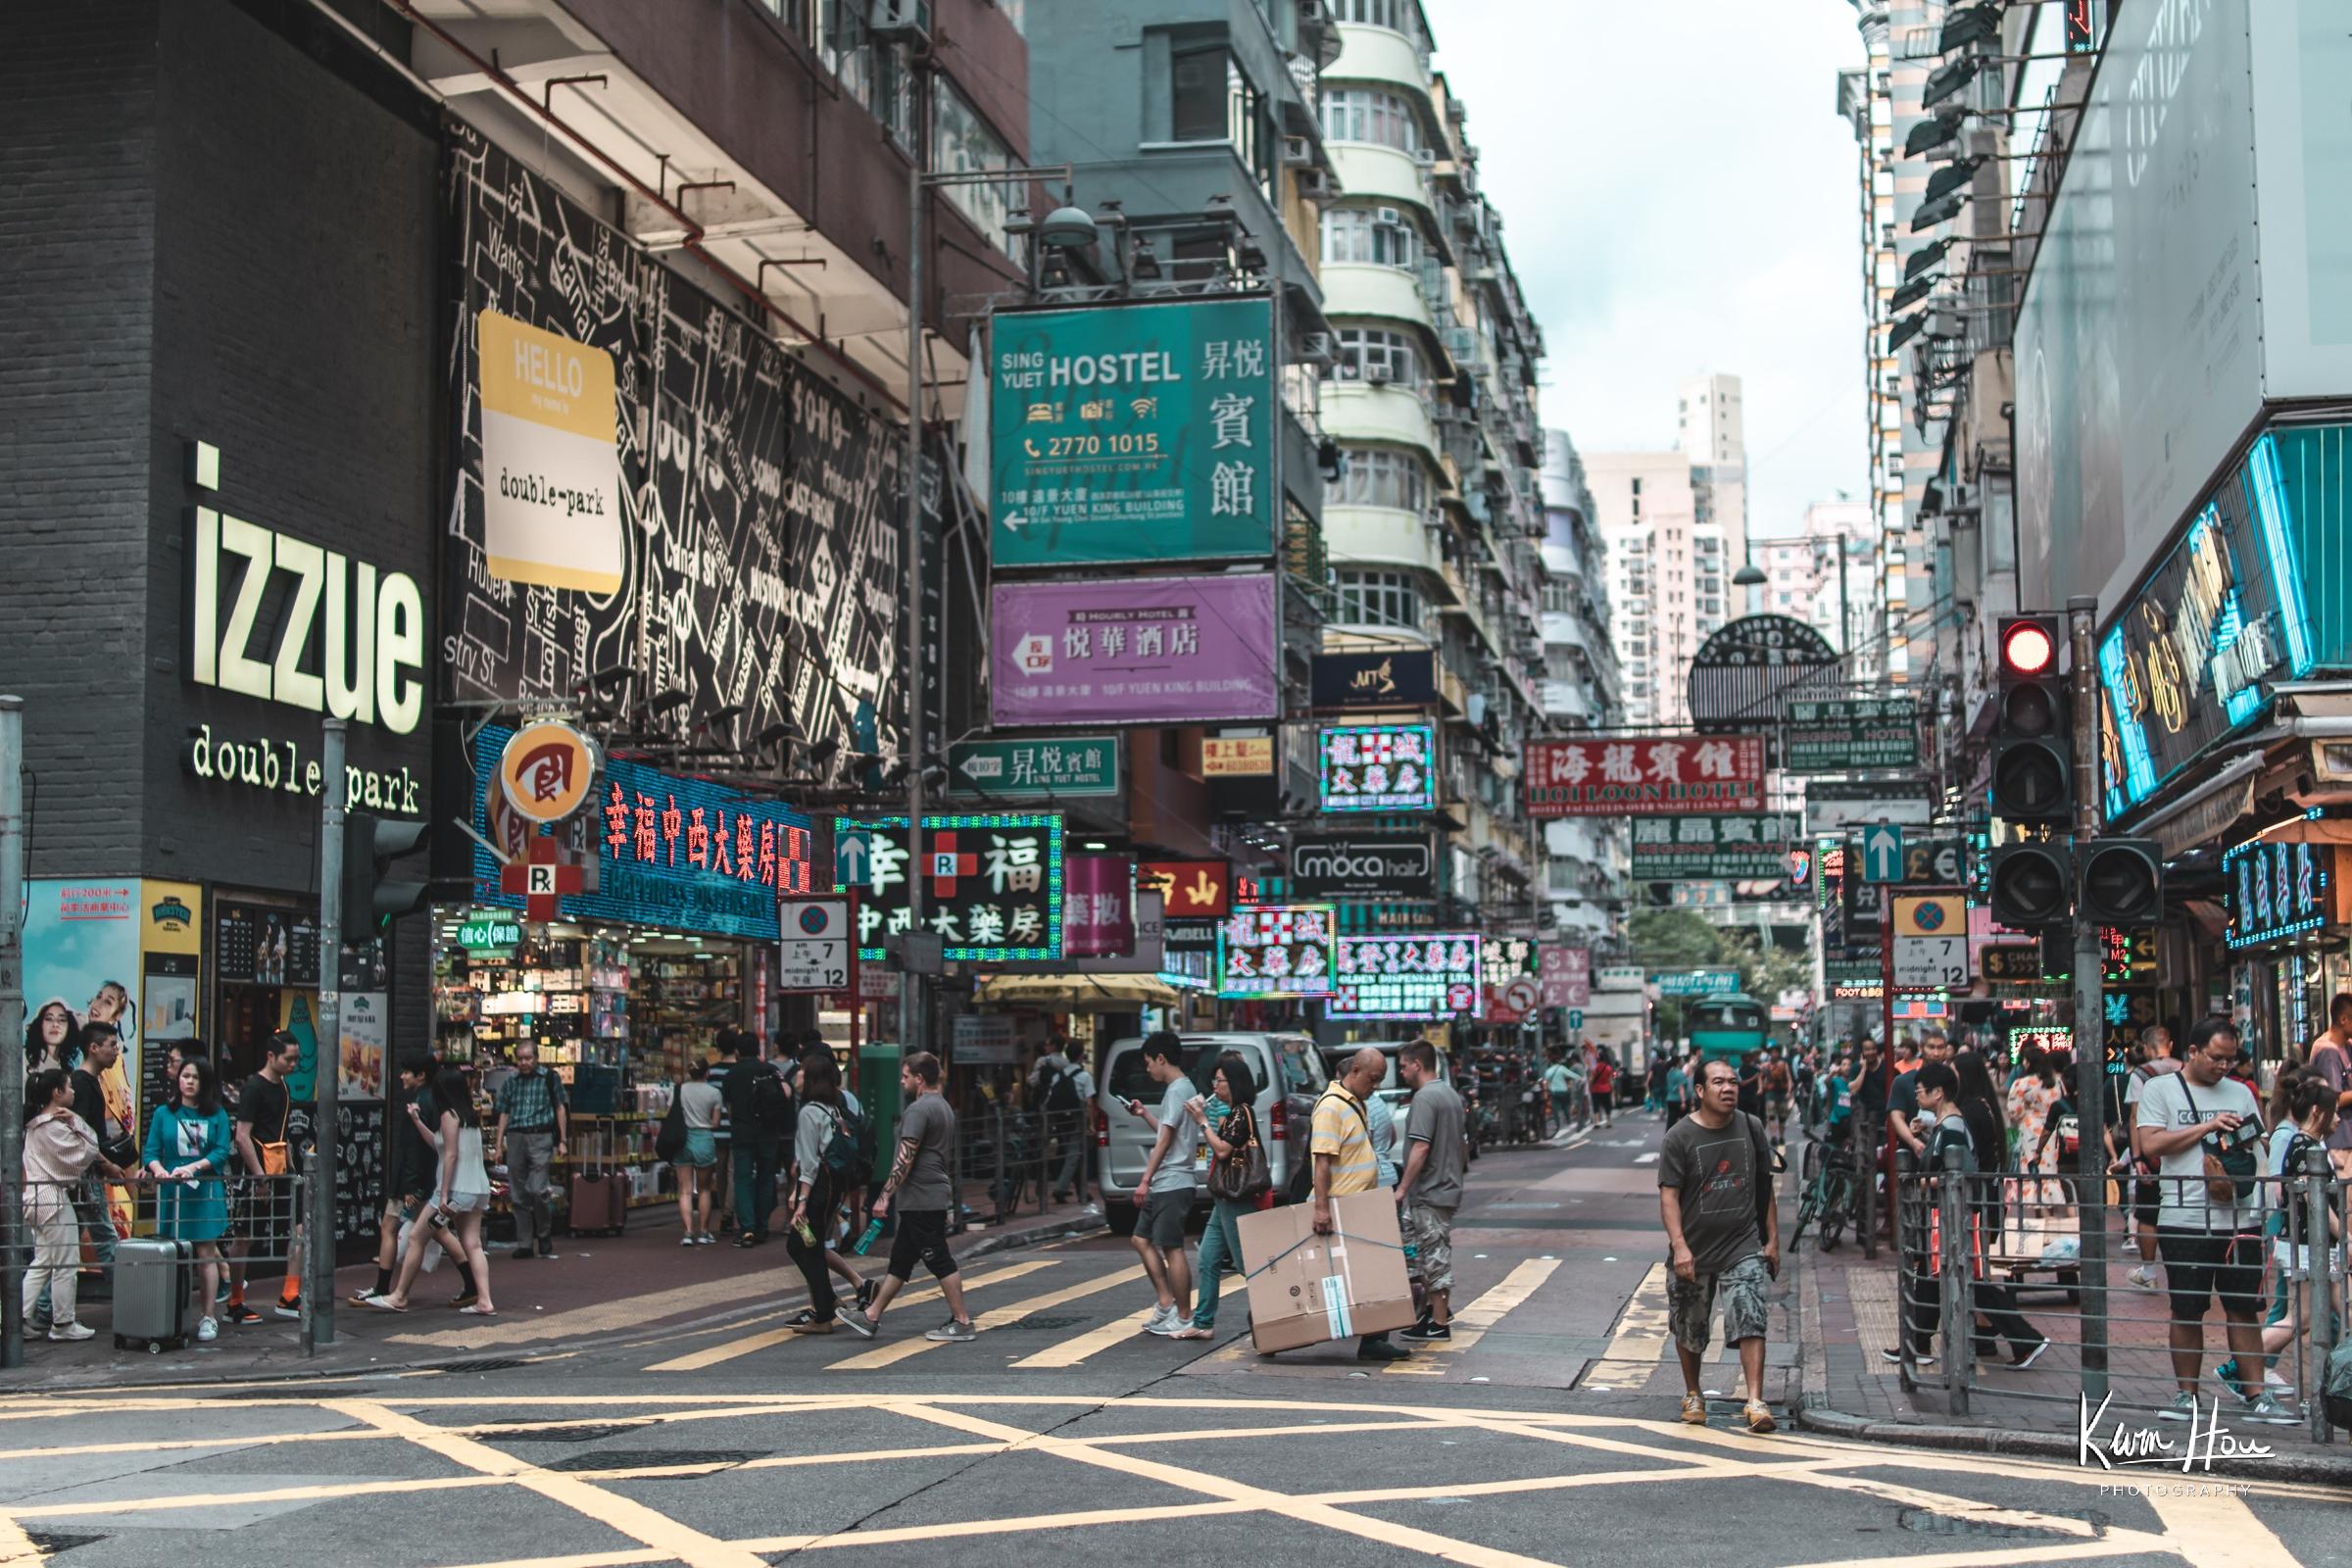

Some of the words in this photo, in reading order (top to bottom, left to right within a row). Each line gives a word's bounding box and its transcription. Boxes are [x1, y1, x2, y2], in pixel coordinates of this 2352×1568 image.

[489, 219, 524, 286] Watts
[514, 338, 583, 398] HELLO
[1002, 352, 1045, 369] SING
[1050, 352, 1181, 386] HOSTEL
[1002, 371, 1045, 389] YUET
[1049, 436, 1100, 456] 2770
[1108, 433, 1158, 454] 1015
[499, 467, 606, 519] double-park
[1023, 506, 1048, 517] 10/F
[1054, 504, 1088, 515] YUEN
[1092, 502, 1120, 514] KING
[1125, 499, 1185, 513] BUILDING
[664, 532, 700, 581] Canal
[702, 549, 716, 588] St
[707, 516, 735, 587] Grand
[815, 554, 833, 590] 22
[194, 440, 423, 735] izzue
[751, 565, 800, 617] HISTORIC
[525, 583, 542, 630] St.
[1089, 610, 1135, 620] HOURLY
[1138, 609, 1174, 619] HOTEL
[710, 602, 732, 663] West
[760, 632, 784, 712] Greene
[1128, 681, 1160, 695] YUEN
[1163, 680, 1193, 694] KING
[1196, 678, 1253, 694] BUILDING
[1864, 728, 1914, 741] HOTEL
[193, 725, 321, 796] double
[345, 764, 419, 813] park
[1054, 774, 1071, 783] YUET
[1075, 773, 1102, 782] HOSTEL
[1530, 784, 1580, 804] HOI
[1587, 784, 1661, 802] LOON
[1669, 781, 1762, 800] HOTEL
[1657, 801, 1690, 810] NIGHT
[605, 781, 776, 887] 幸福中西大藥房
[1732, 843, 1786, 854] HOTE
[1304, 856, 1384, 878] moca
[1386, 858, 1421, 877] hair
[1379, 912, 1409, 925] HAIR
[461, 926, 519, 945] 信心保證
[822, 943, 834, 959] 7
[1939, 940, 1952, 956] 7
[784, 966, 819, 975] midnight
[824, 969, 845, 986] 12
[1898, 964, 1936, 973] midnight
[1941, 967, 1964, 984] 12
[1835, 987, 1860, 998] FOOT
[2105, 994, 2129, 1025] ¥
